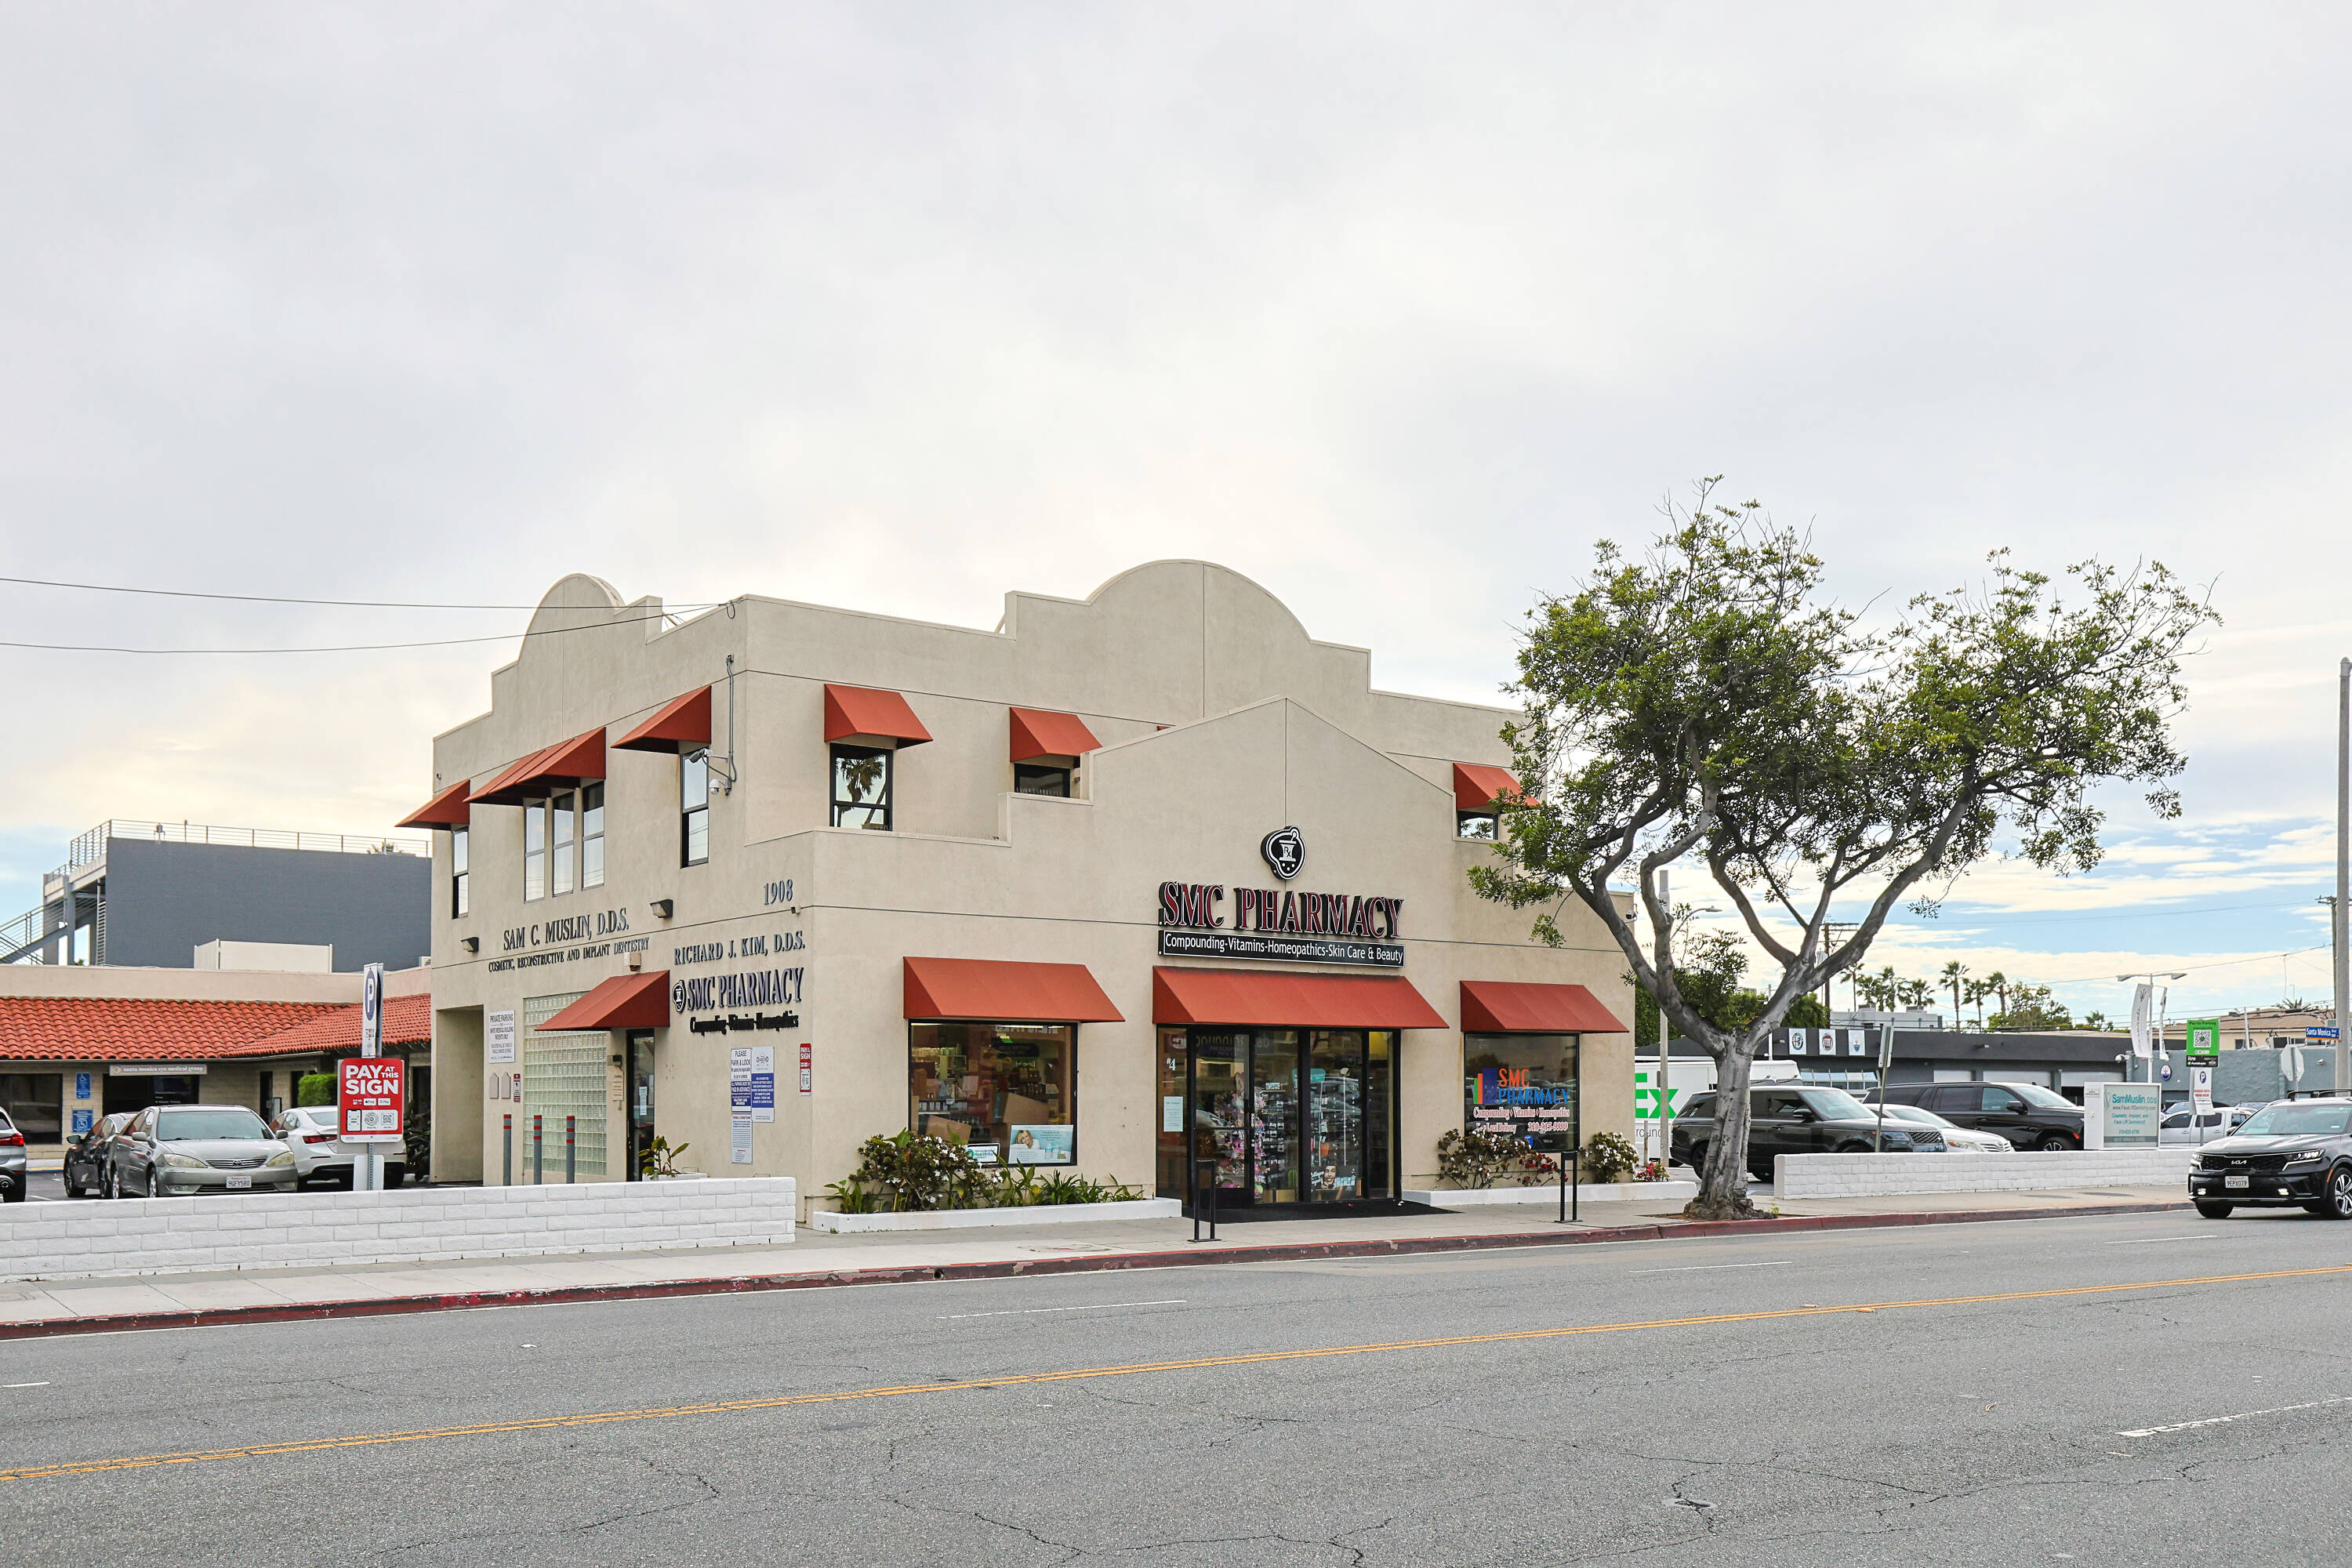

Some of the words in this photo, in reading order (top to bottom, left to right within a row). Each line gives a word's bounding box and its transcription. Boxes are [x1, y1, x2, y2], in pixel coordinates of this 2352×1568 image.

[764, 879, 793, 905] 1908
[1159, 880, 1224, 928] SMC
[1234, 887, 1404, 938] PHARMACY
[503, 927, 525, 950] SAM
[531, 924, 540, 946] C.
[546, 914, 592, 944] MUSLIN,
[597, 907, 630, 935] D.D.S.
[488, 958, 515, 972] COSMETIC,
[517, 952, 564, 969] RECONSTRUCTIVE
[567, 948, 579, 961] AND
[583, 944, 611, 959] IMPLANT
[614, 938, 649, 955] DENTISTRY
[673, 942, 723, 965] RICHARD
[728, 940, 736, 958] J.
[742, 935, 768, 956] KIM,
[773, 931, 806, 953] D.D.S.
[1347, 945, 1366, 959] Care
[1367, 947, 1374, 960] &
[1377, 947, 1403, 964] Beauty
[688, 976, 715, 1011] SMC
[717, 967, 804, 1008] PHARMACY
[346, 1065, 383, 1079] PAY
[1167, 1058, 1176, 1070] #4
[345, 1079, 398, 1094] SIGN
[1498, 1068, 1530, 1087] SMC
[1498, 1089, 1570, 1105] PHARMACY
[1473, 1106, 1510, 1120] Compounding
[1513, 1106, 1536, 1117] Vitamins
[1538, 1106, 1570, 1120] Homeopathics
